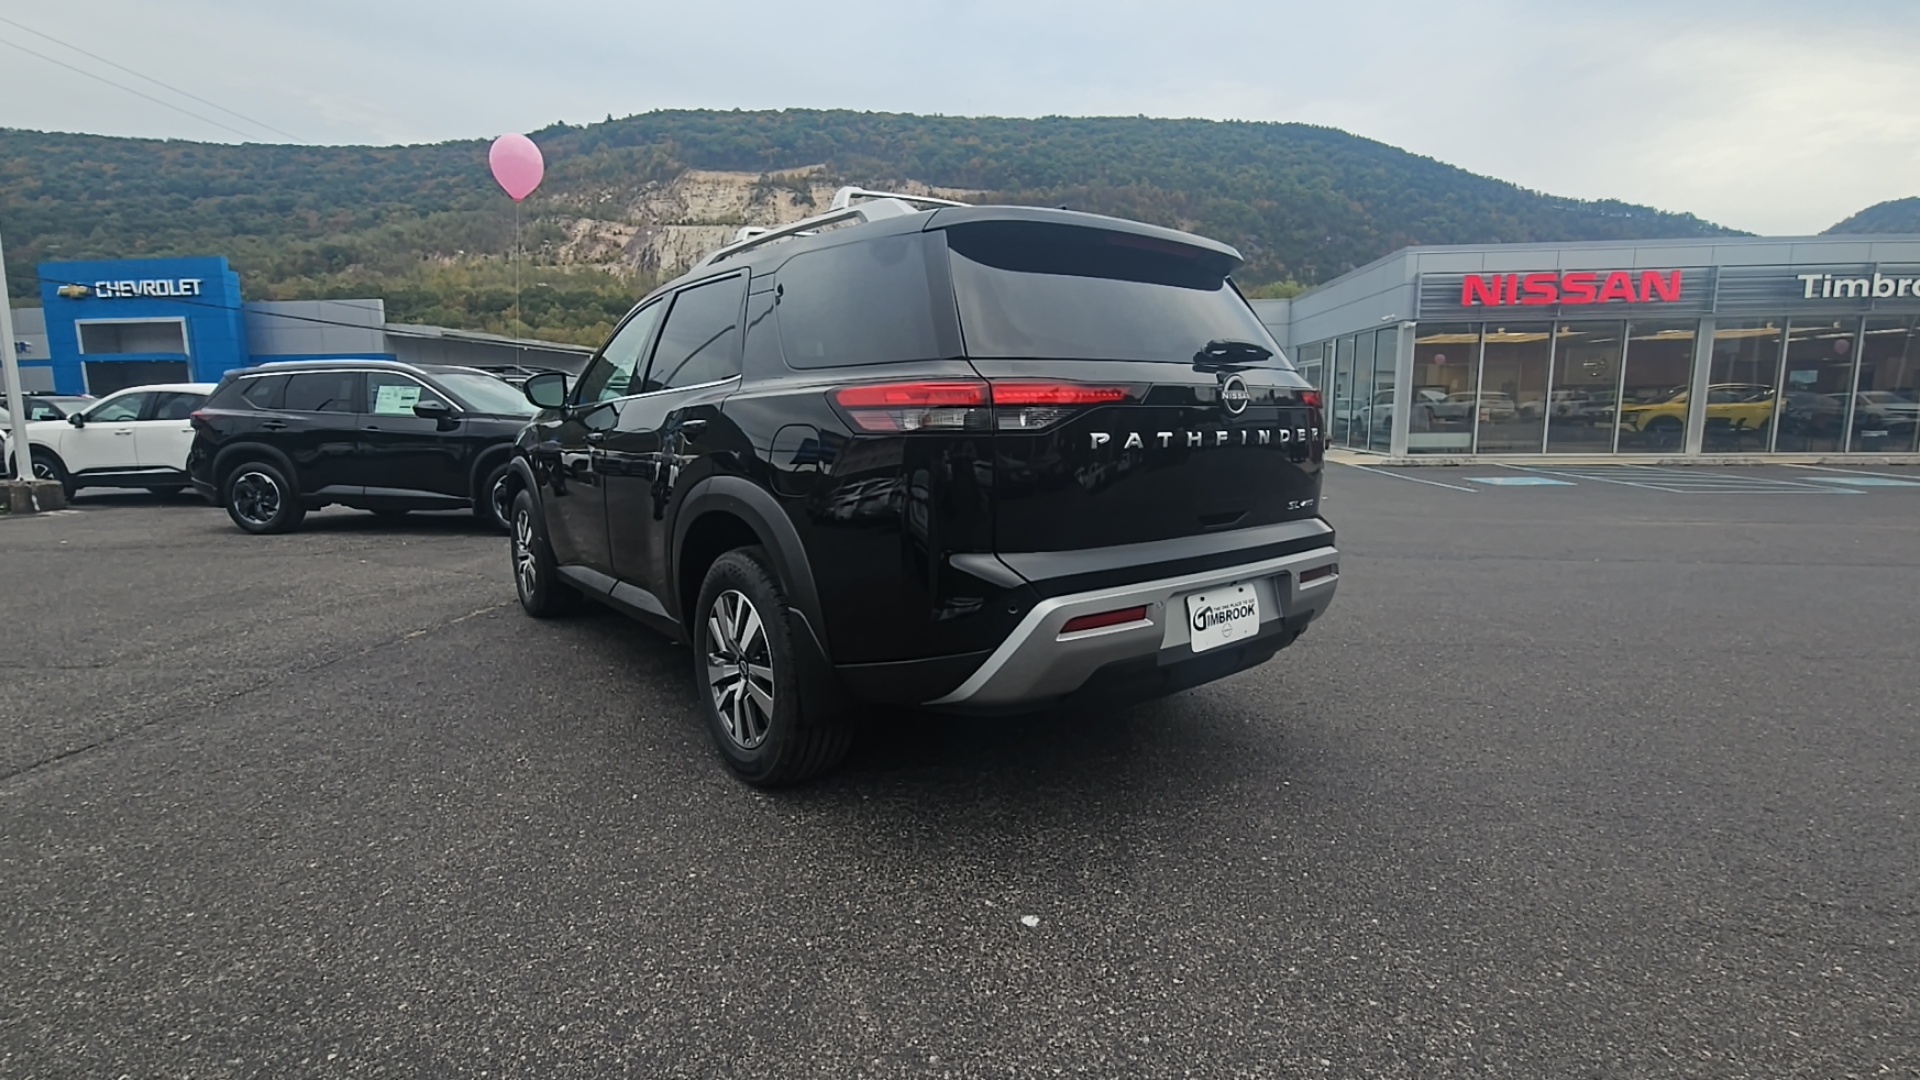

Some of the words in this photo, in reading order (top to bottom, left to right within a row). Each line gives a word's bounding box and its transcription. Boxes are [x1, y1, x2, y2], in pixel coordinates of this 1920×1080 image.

[96, 279, 201, 298] CHEVROLET
[1461, 270, 1682, 307] NISSAN
[1089, 428, 1319, 450] PATHFINDER
[1193, 603, 1255, 631] TIMBROOK
